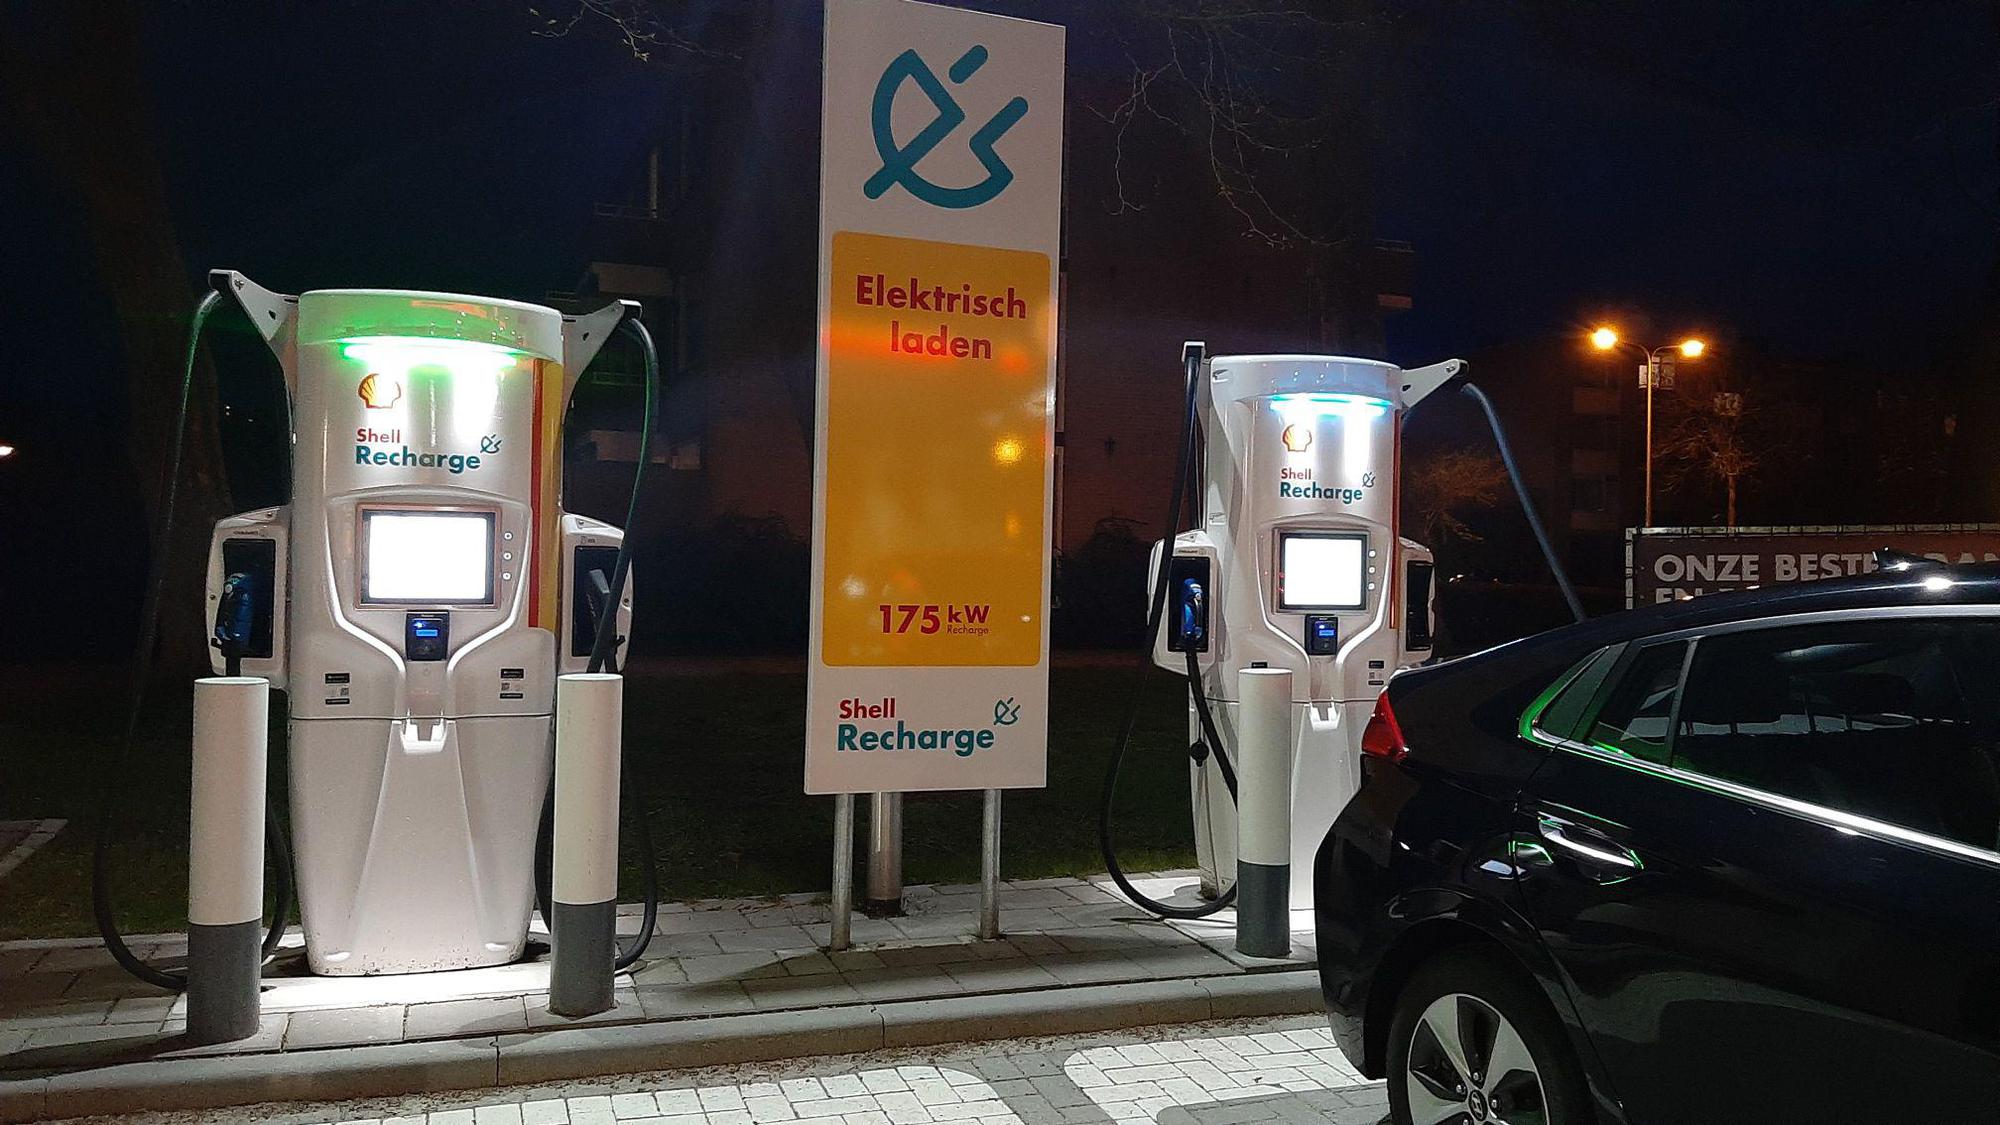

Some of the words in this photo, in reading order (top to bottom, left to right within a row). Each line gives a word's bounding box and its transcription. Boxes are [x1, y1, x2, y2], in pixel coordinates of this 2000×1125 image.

[857, 274, 1026, 318] Elektrisch
[891, 321, 992, 359] laden
[356, 428, 400, 443] Shell
[355, 445, 481, 474] Recharge
[1281, 468, 1312, 480] Shell
[1280, 481, 1363, 504] Recharge
[1654, 554, 1760, 581] ONZE
[880, 604, 941, 634] 175
[948, 604, 990, 623] kW
[947, 624, 989, 636] Recharge
[839, 698, 896, 719] Shell
[837, 721, 994, 757] Recharge
